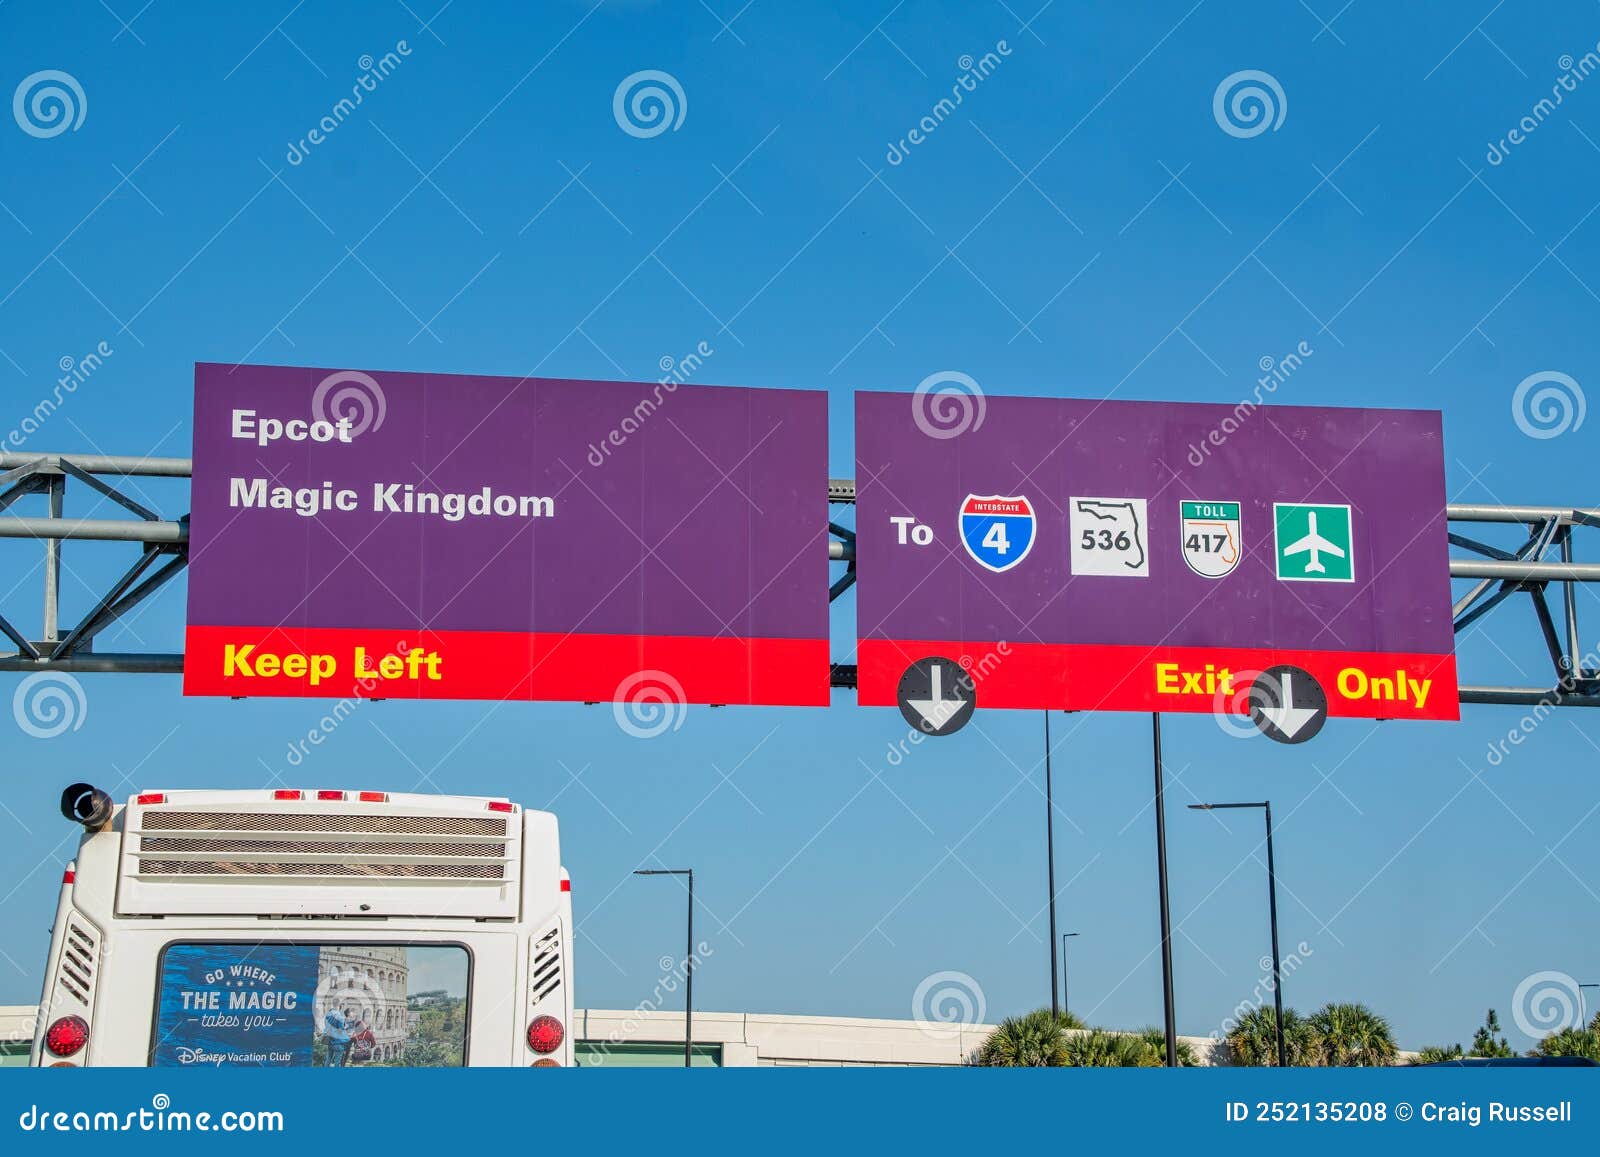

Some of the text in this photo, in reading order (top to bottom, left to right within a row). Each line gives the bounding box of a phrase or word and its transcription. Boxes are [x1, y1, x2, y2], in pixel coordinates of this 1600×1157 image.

[232, 409, 352, 445] Epcot
[230, 477, 555, 521] Magic Kingdom
[974, 503, 1020, 512] INTERSTATE
[1194, 504, 1227, 517] TOLL
[890, 516, 934, 546] To
[981, 522, 1010, 555] 4
[1081, 529, 1131, 552] 536
[1185, 534, 1227, 553] 417
[223, 644, 443, 685] Keep Left
[1155, 662, 1432, 708] Exit Only
[205, 965, 276, 985] GO WHERE
[181, 991, 298, 1010] THE MAGIC
[201, 1012, 274, 1032] takes you
[228, 1052, 267, 1062] Vacation
